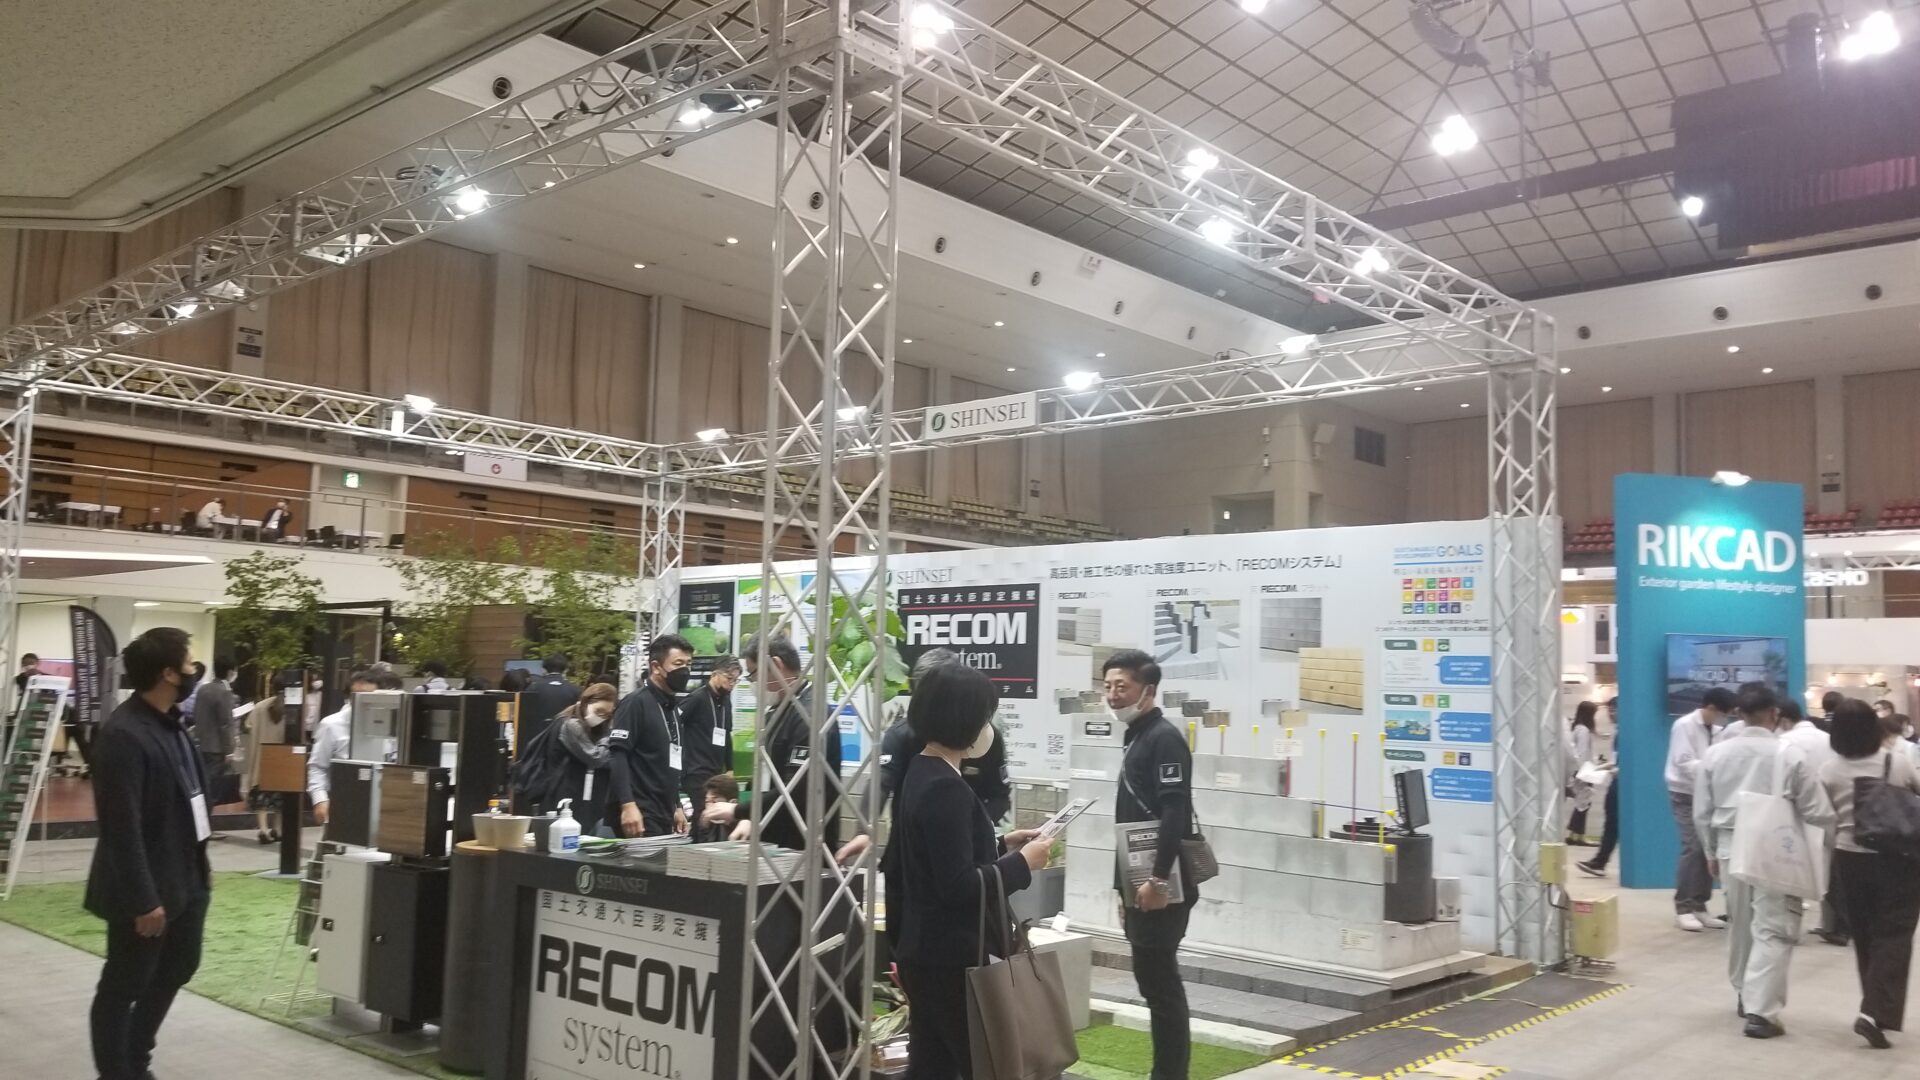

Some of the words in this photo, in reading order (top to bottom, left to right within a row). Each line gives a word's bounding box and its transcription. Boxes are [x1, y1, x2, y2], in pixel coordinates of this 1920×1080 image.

[951, 401, 1027, 428] SHINSEI
[1637, 523, 1797, 573] RIKCAD
[897, 568, 953, 584] SHINSEI
[1639, 576, 1678, 587] Exterior
[1679, 580, 1715, 591] garden
[1715, 579, 1754, 593] lifestyle
[1754, 581, 1797, 595] designer
[906, 612, 1028, 645] RECOM
[597, 874, 649, 894] SHINSEI
[542, 892, 720, 943] 国土交通大臣認定擁
[536, 933, 719, 1035] RECOM
